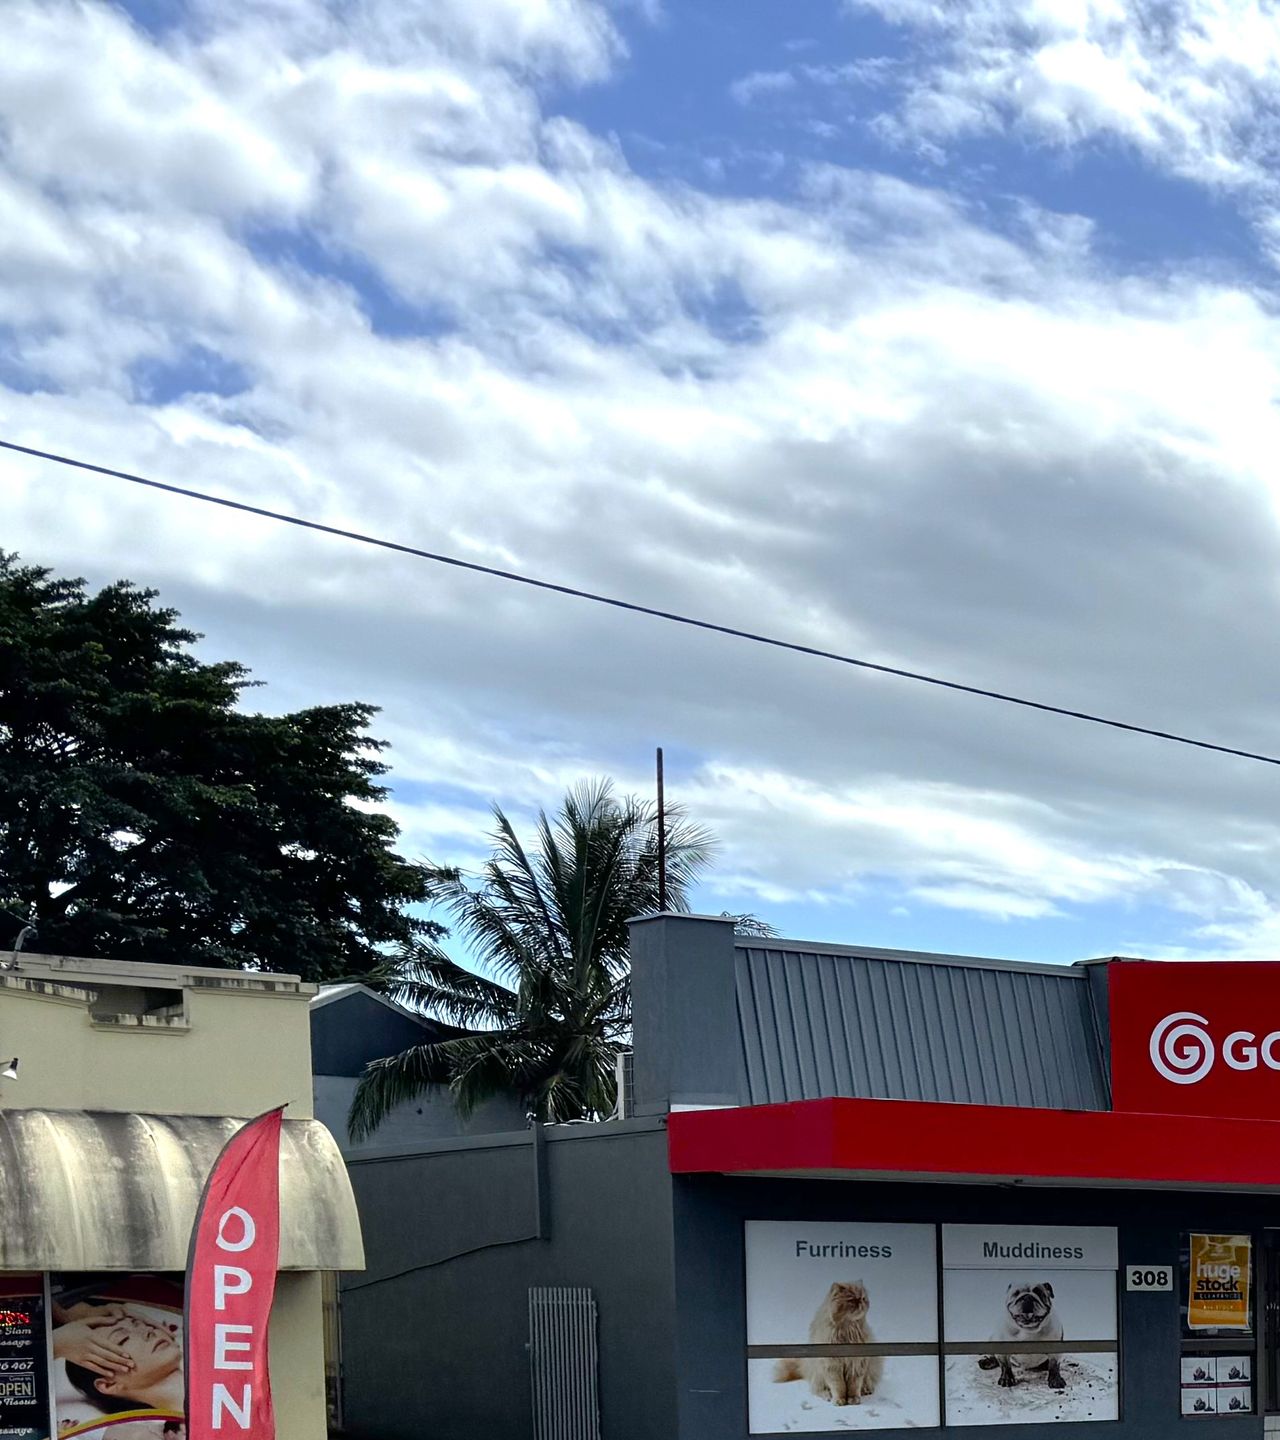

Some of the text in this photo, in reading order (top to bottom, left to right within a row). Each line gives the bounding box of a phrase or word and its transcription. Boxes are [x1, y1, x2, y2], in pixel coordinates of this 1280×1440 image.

[796, 1241, 892, 1258] Furriness
[983, 1241, 1083, 1260] Muddiness
[1131, 1270, 1169, 1287] 308
[1196, 1258, 1241, 1283] huge
[1196, 1276, 1239, 1291] stock
[211, 1206, 256, 1430] OPEN
[0, 1340, 31, 1348] ssage
[11, 1361, 34, 1370] 467
